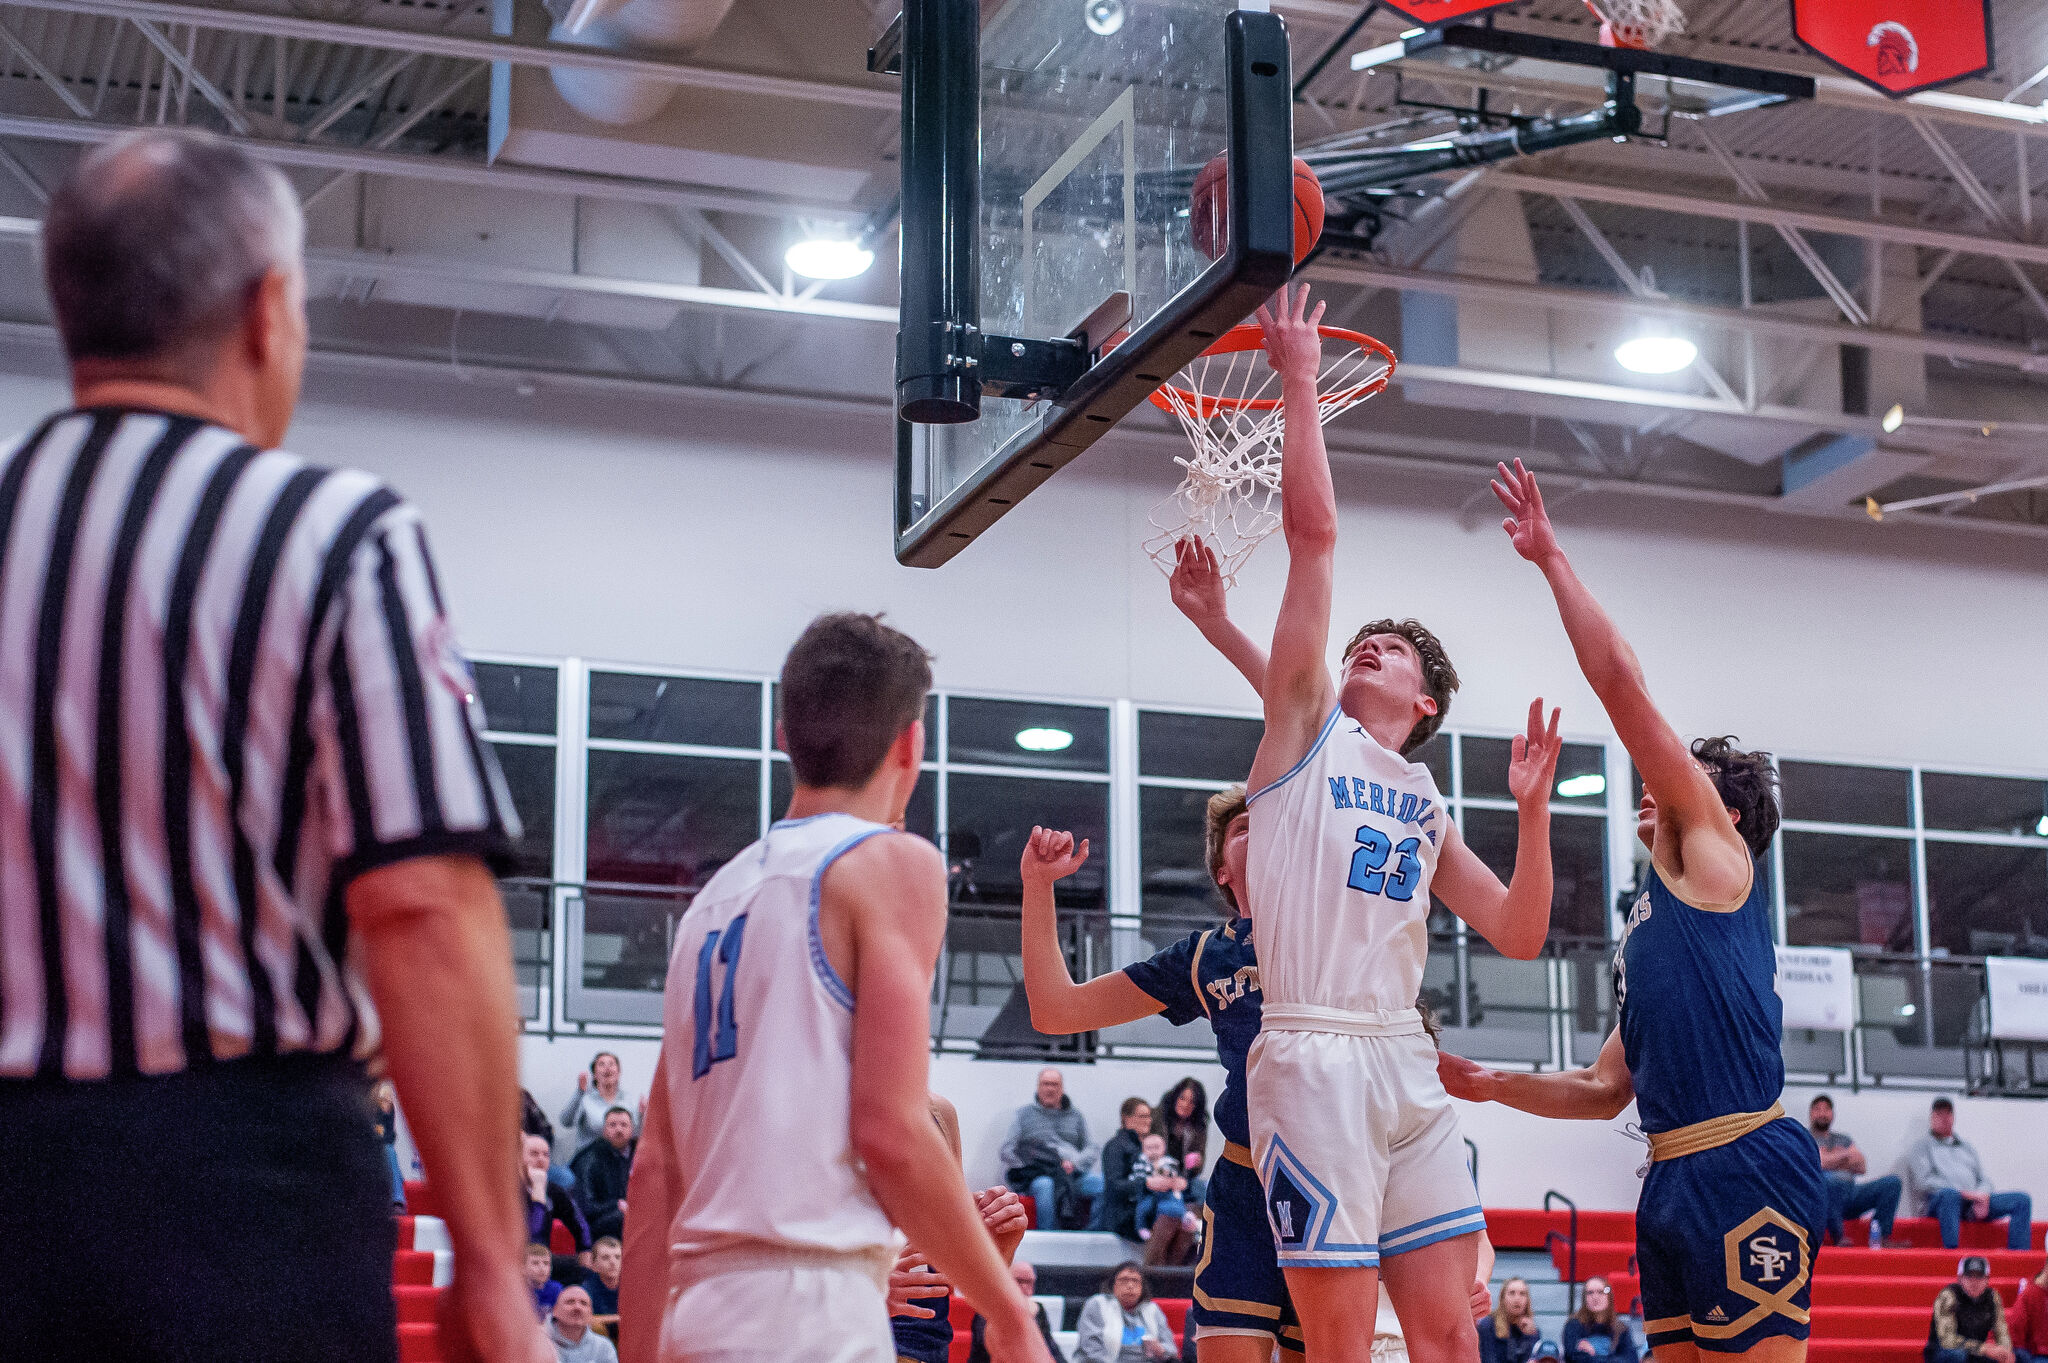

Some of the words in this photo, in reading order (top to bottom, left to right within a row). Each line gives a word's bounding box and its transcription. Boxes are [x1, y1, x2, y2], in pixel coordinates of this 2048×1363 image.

[1328, 775, 1437, 847] MERIDI
[1347, 824, 1422, 902] 23
[692, 911, 749, 1082] 11
[1276, 1200, 1295, 1237] M
